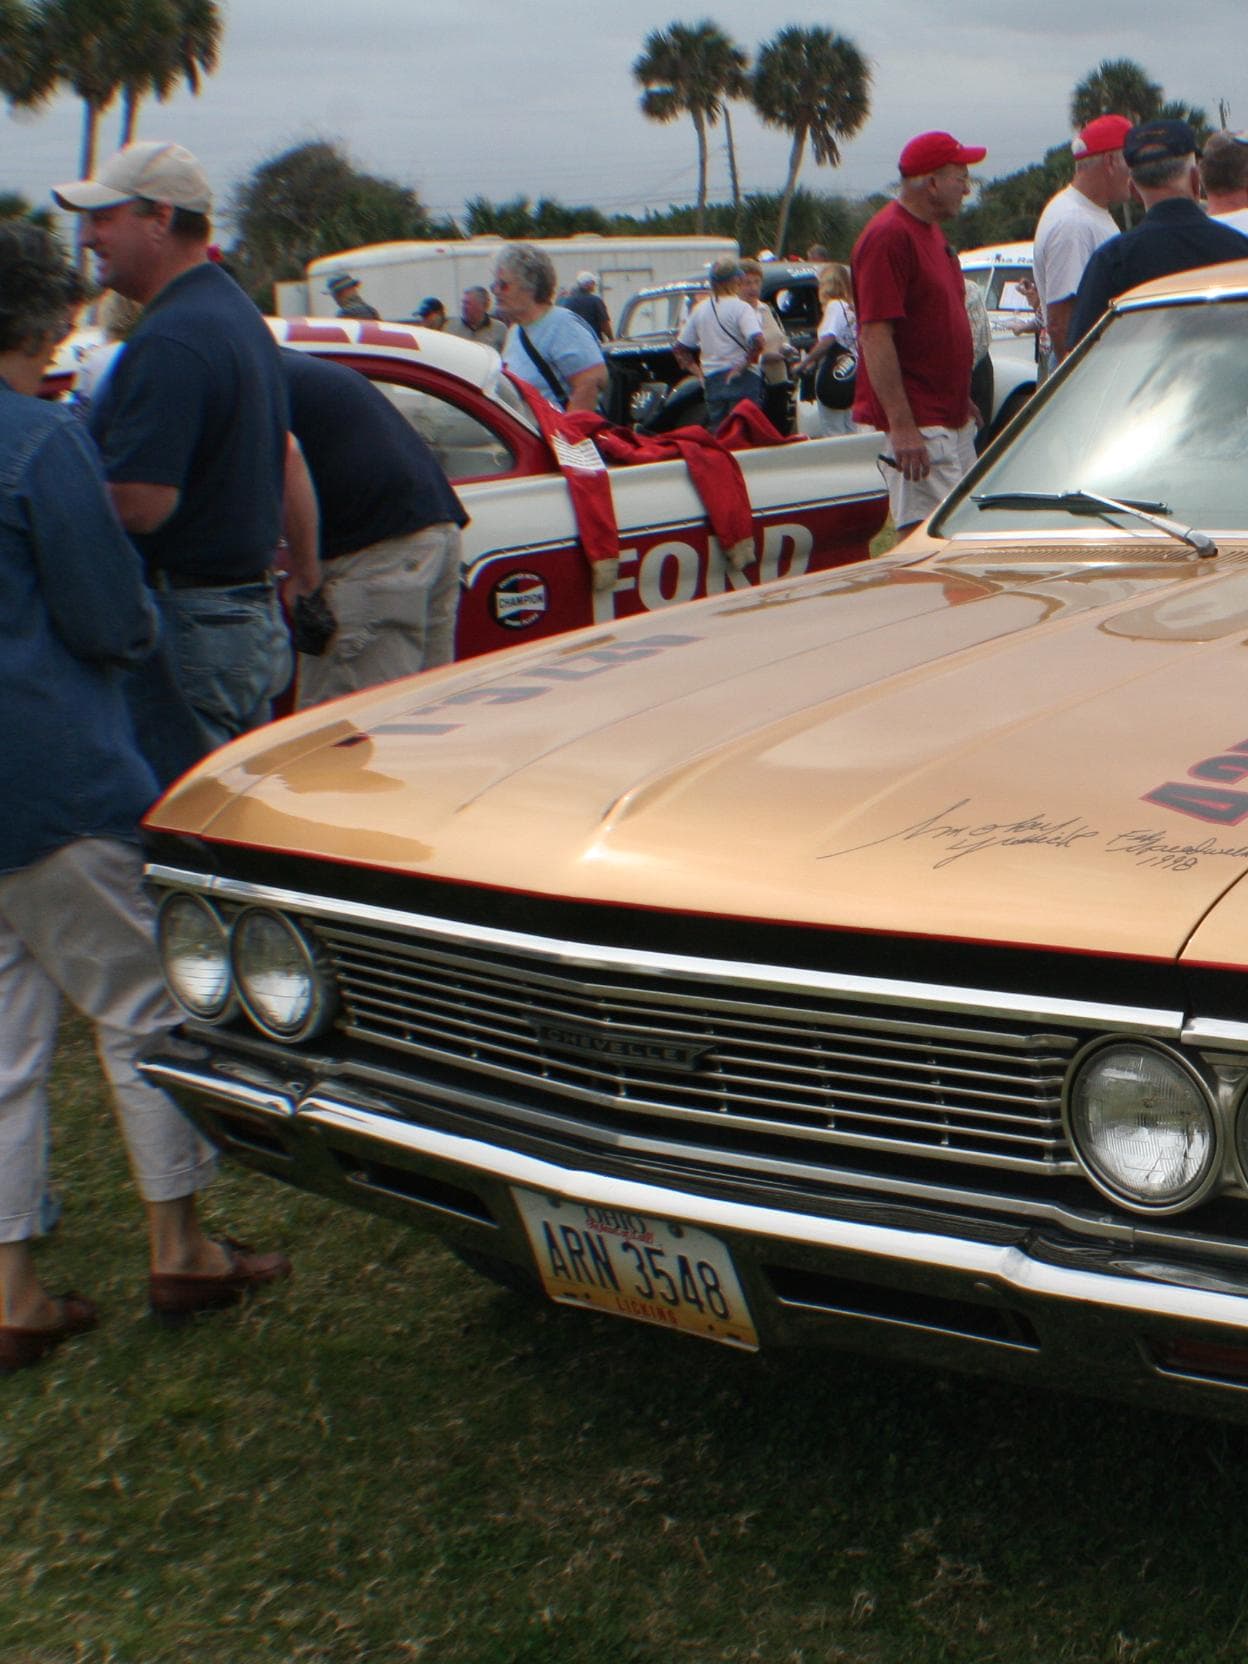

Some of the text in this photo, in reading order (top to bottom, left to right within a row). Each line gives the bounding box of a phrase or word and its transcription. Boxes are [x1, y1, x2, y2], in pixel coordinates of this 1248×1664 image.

[499, 593, 543, 609] CHAMPION
[1136, 854, 1198, 872] 1998
[545, 1028, 681, 1064] CHEVELLE
[583, 1207, 648, 1234] OHIO
[542, 1220, 730, 1321] ARN 3548
